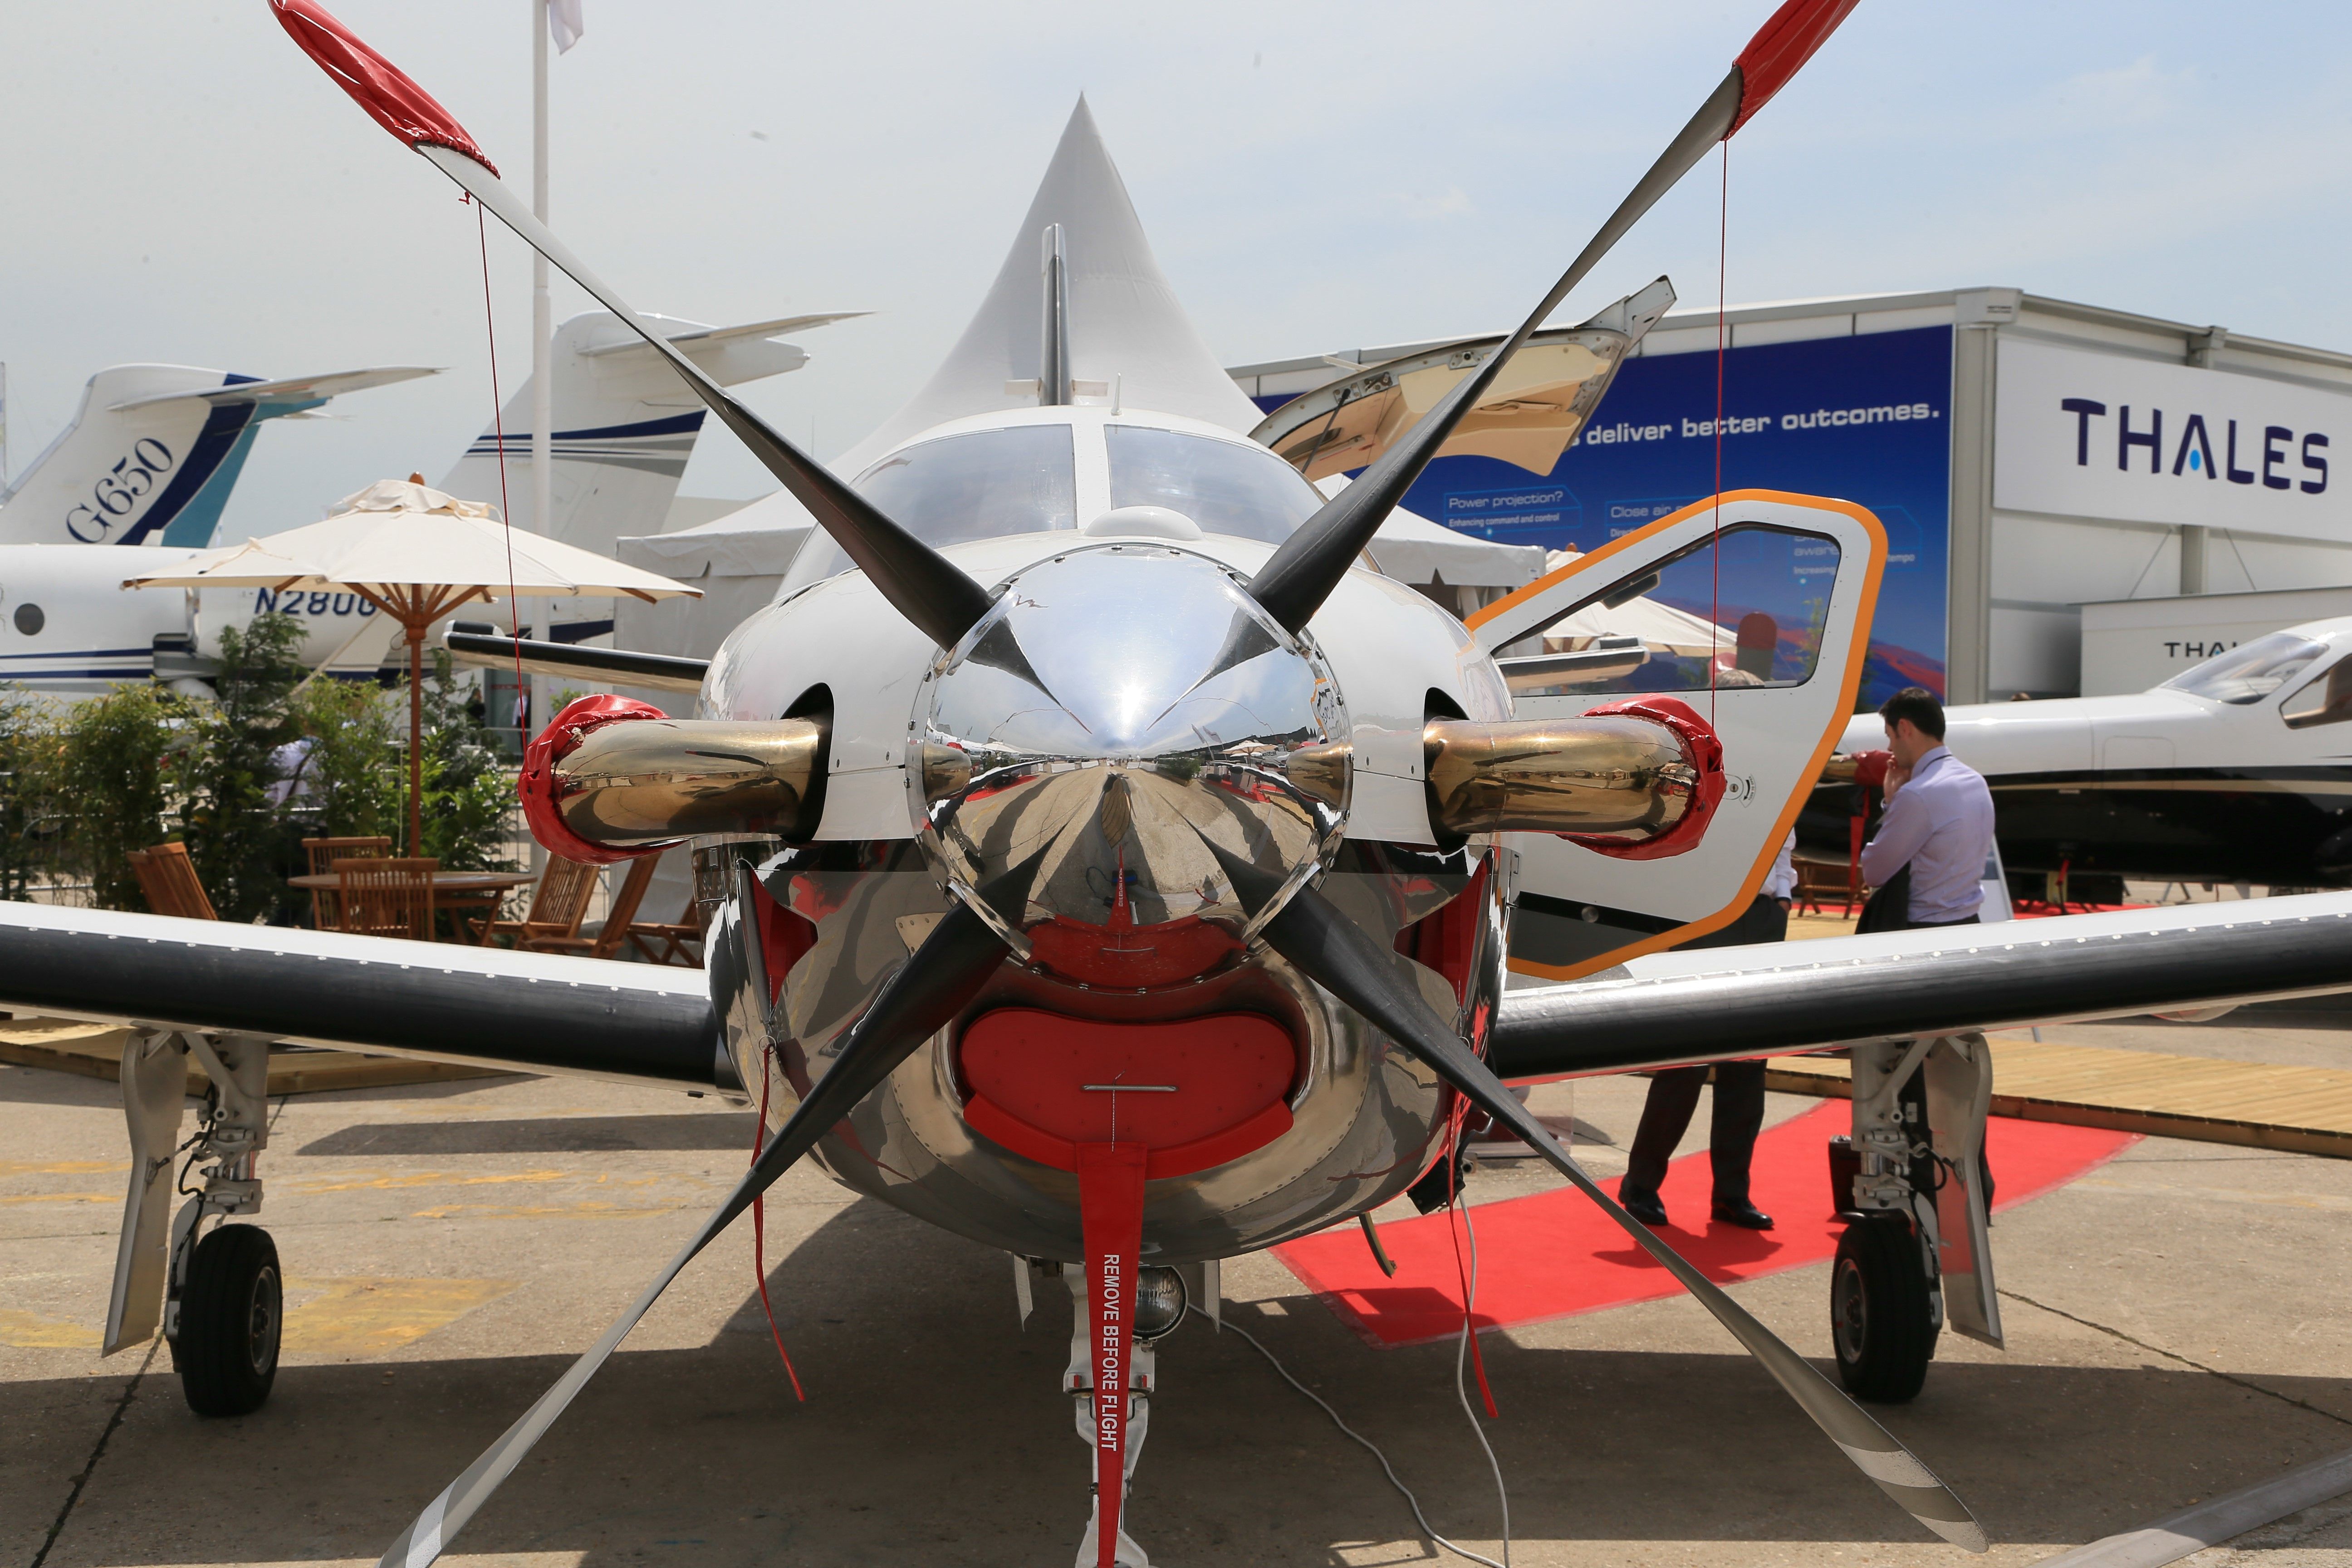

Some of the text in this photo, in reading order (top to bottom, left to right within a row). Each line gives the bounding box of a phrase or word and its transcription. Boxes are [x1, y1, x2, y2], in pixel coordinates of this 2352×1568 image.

[1586, 423, 1672, 445] deliver
[1682, 417, 1771, 437] better
[1781, 403, 1940, 430] outcomes.
[2061, 398, 2329, 494] THALES
[67, 438, 173, 544] G650
[1449, 490, 1563, 509] Power projection?
[1449, 513, 1559, 527] Enhancing command and control
[1611, 506, 1648, 518] Close
[1653, 505, 1671, 516] air
[255, 587, 390, 616] N280G
[1101, 1254, 1119, 1451] REMOVE BEFORE FLIGHT
